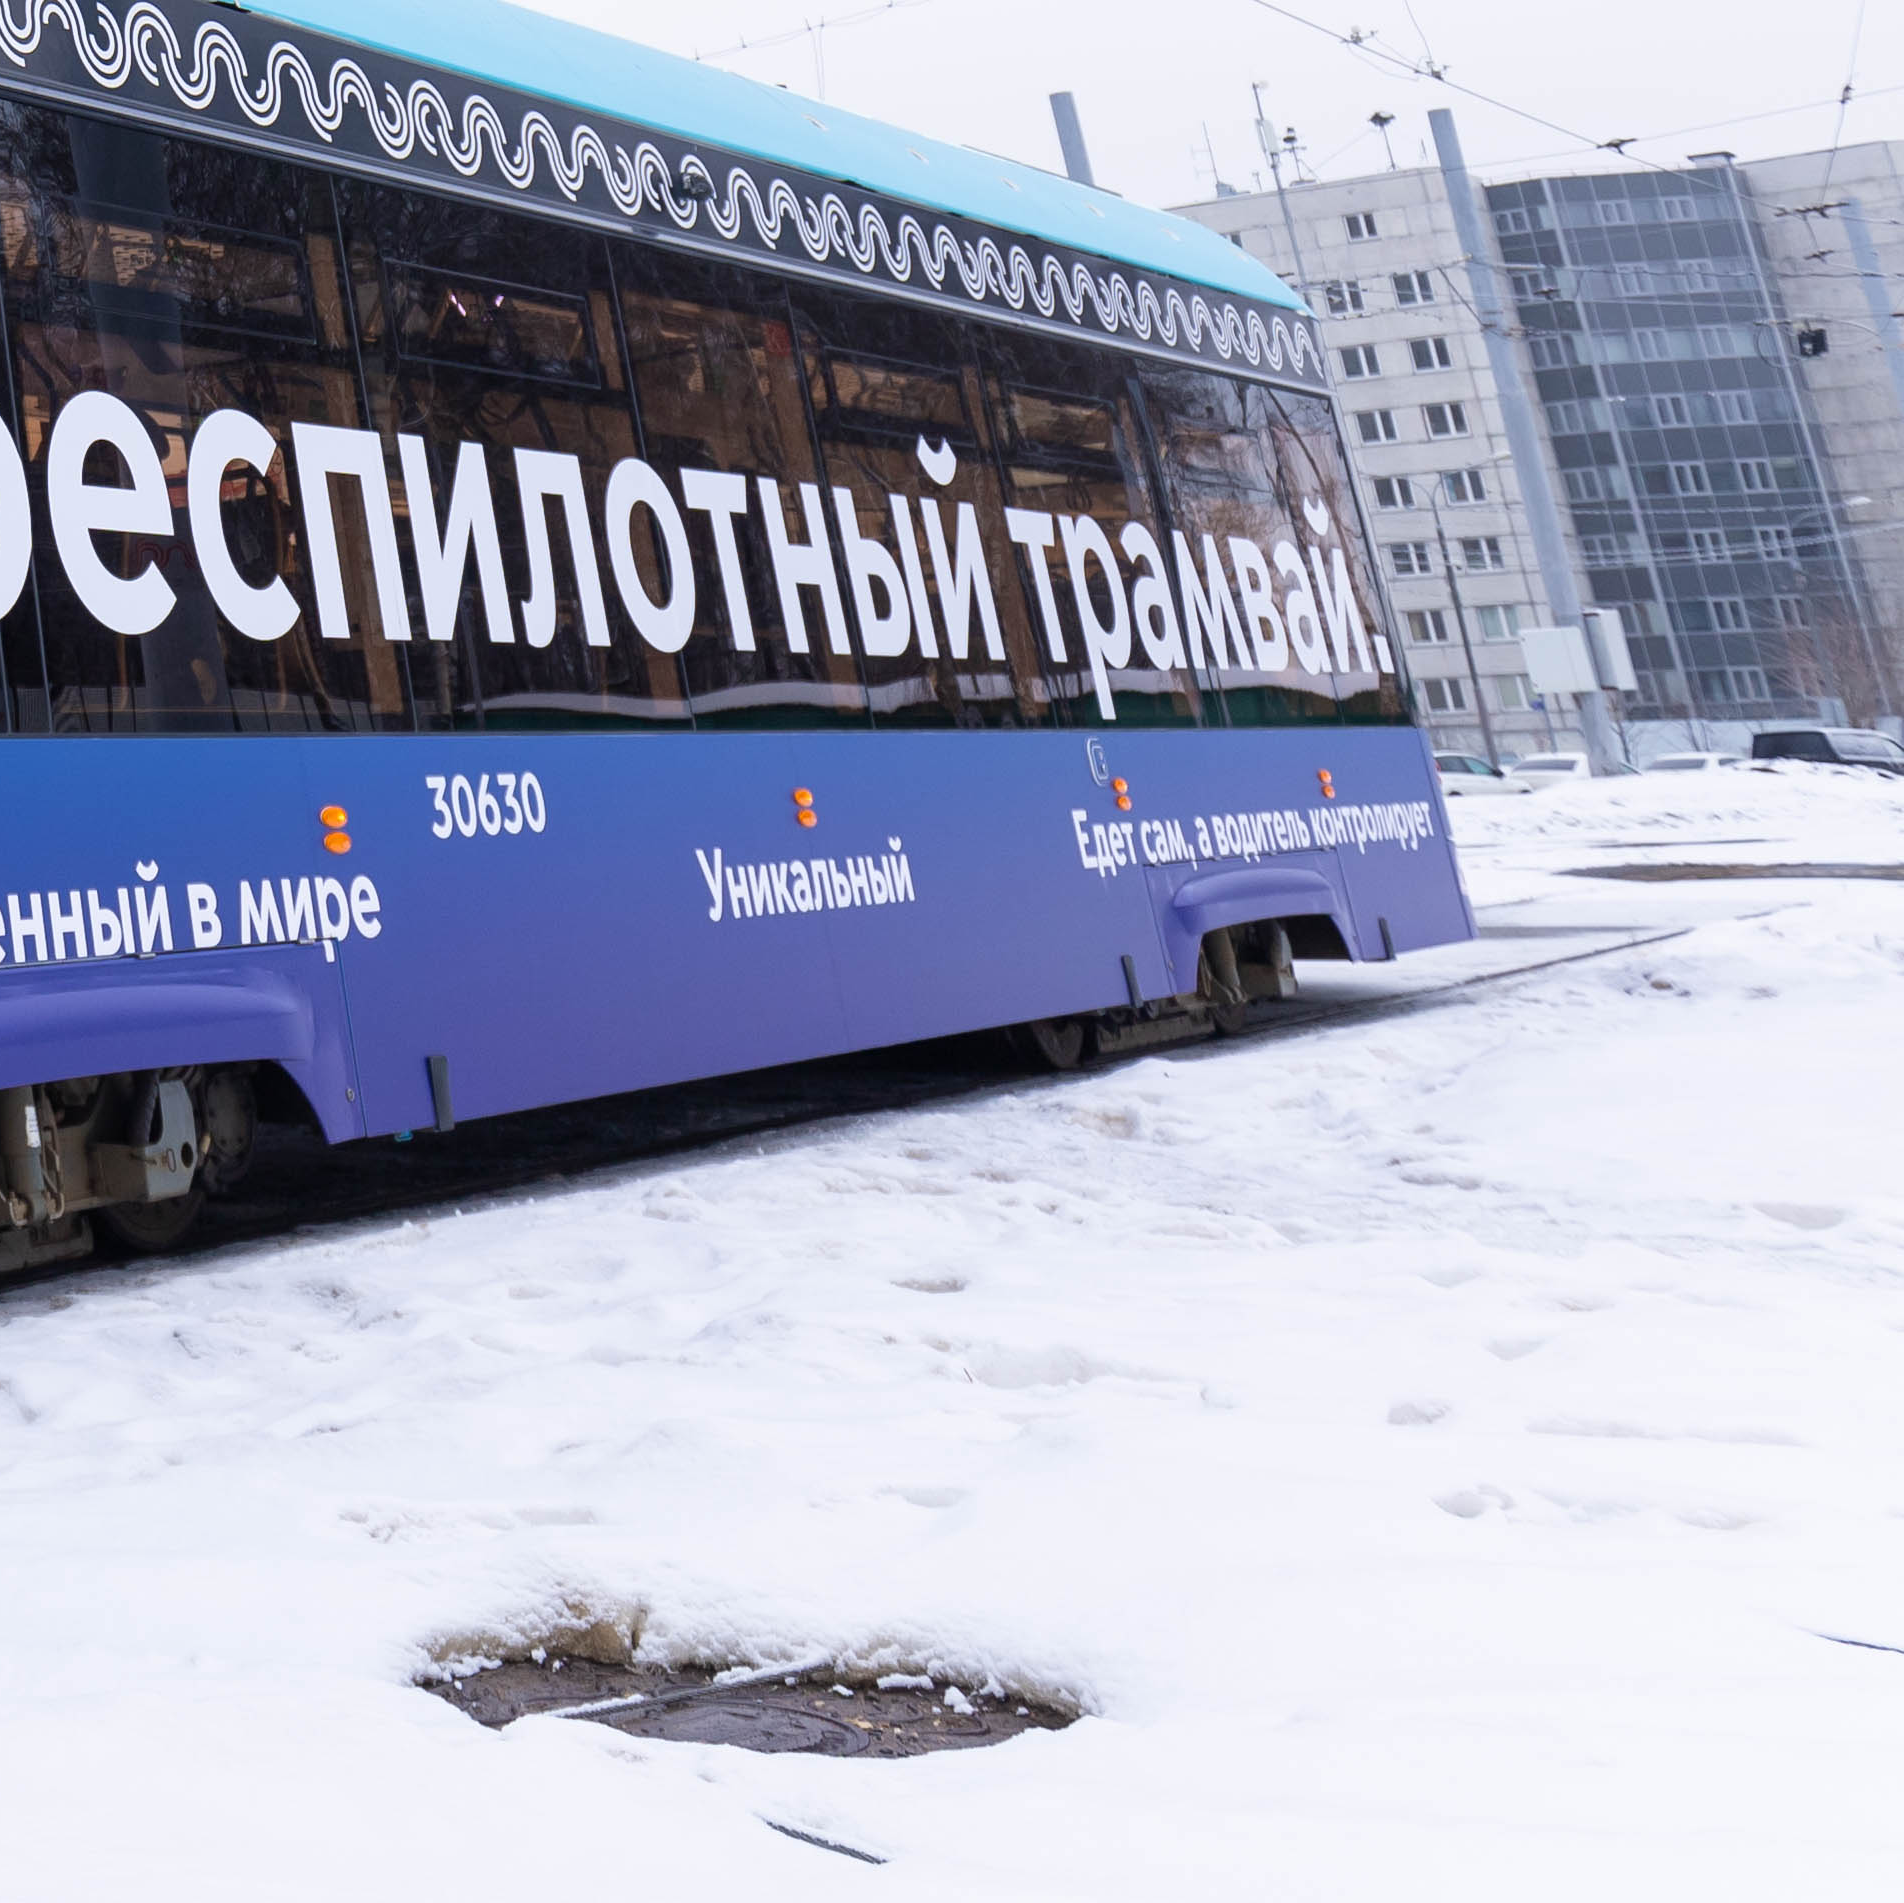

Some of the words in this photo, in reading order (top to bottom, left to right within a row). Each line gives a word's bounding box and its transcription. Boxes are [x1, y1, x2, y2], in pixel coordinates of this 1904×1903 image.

[1004, 495, 1395, 721] трамвай.
[426, 772, 546, 839] 30630
[1071, 809, 1137, 878] Едет
[1141, 819, 1197, 871] сам,
[1194, 816, 1214, 858] а
[1211, 810, 1311, 863] водитель
[1308, 801, 1434, 855] контролирует
[187, 883, 223, 949] в
[239, 874, 383, 963] мире
[695, 836, 915, 922] Уникальный
